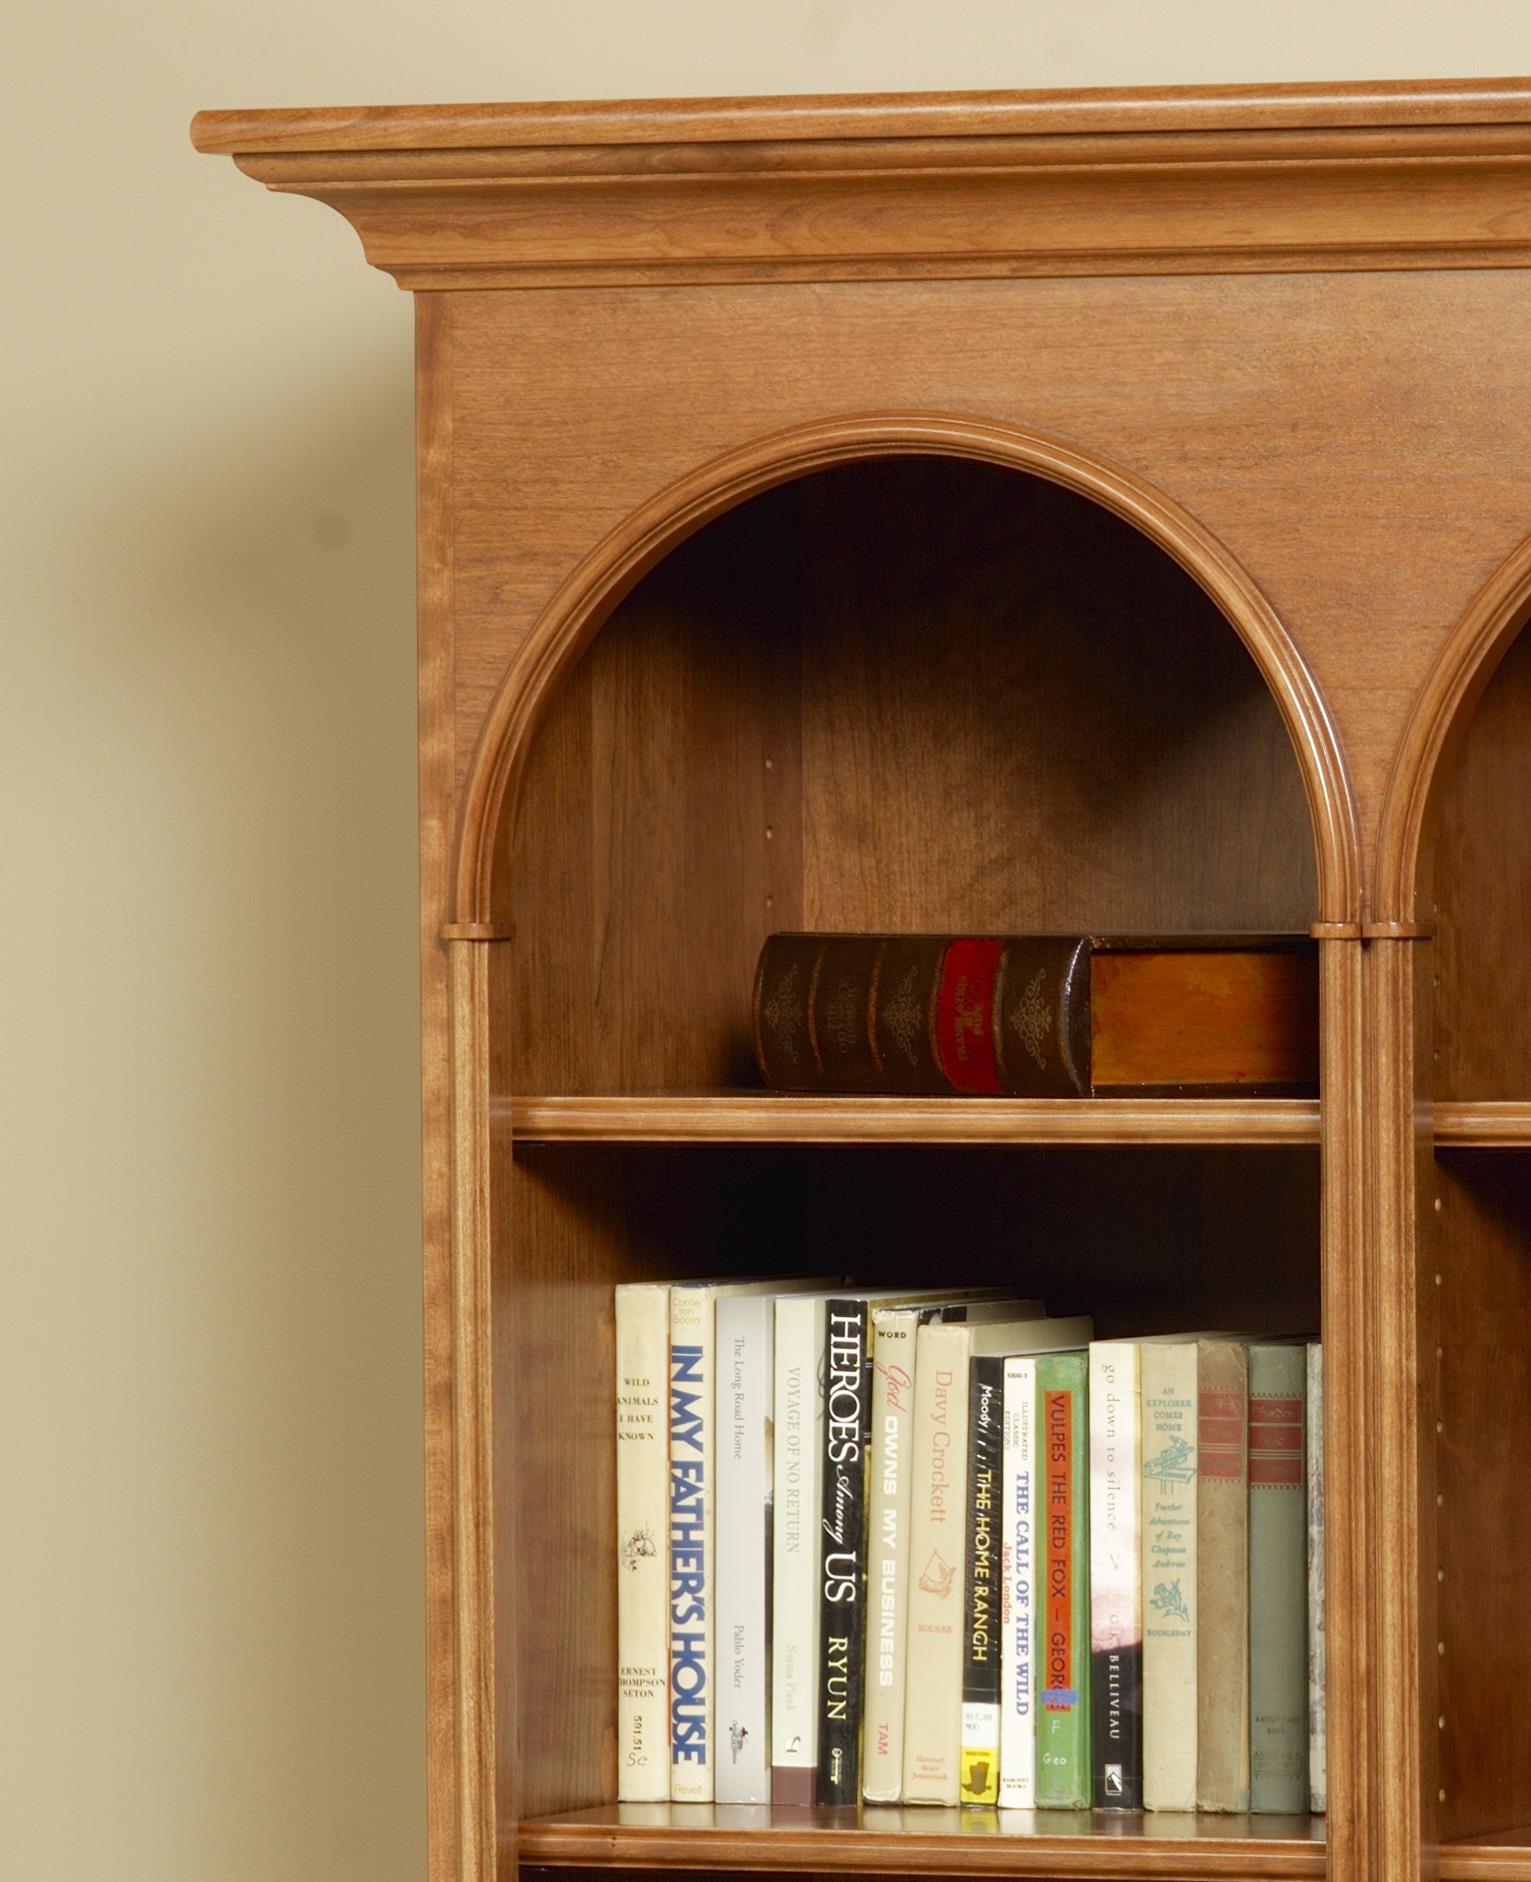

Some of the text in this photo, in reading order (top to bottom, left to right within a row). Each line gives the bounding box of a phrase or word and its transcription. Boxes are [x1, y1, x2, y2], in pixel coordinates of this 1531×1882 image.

[878, 1331, 907, 1339] WORD
[624, 1378, 650, 1386] WILD
[730, 1336, 745, 1459] The Long Road Home
[1162, 1387, 1175, 1395] AN
[617, 1397, 658, 1405] ANIMALS
[1147, 1400, 1192, 1408] EXPLORER
[1154, 1411, 1183, 1419] COMES
[619, 1415, 653, 1423] I HAVE
[1156, 1423, 1182, 1431] HOME
[618, 1433, 654, 1441] KNOWN
[930, 1371, 953, 1523] Davy Crockett
[1101, 1364, 1120, 1530] go down to silence
[786, 1367, 801, 1553] VOYAGE OF NO RETURN
[974, 1384, 994, 1579] Moody THE HOME
[1051, 1395, 1067, 1598] VULPES THE RED FOX
[823, 1313, 861, 1720] HEROES Among US RYUN
[671, 1345, 706, 1765] IN MY FATHER'S HOUSE
[875, 1360, 912, 1755] God OWNS MY BUSINESS TAM
[1002, 1543, 1012, 1624] Jack London
[1016, 1472, 1030, 1716] THE CALL OF THE WILD
[1147, 1629, 1192, 1637] DOUBLEDAY
[621, 1668, 657, 1676] ERNEST
[734, 1625, 745, 1688] Pablo Yoder
[624, 1690, 655, 1698] SETON
[1109, 1655, 1120, 1739] BELLIVEAU
[633, 1715, 643, 1750] 591.51
[1043, 1753, 1067, 1765] Geo
